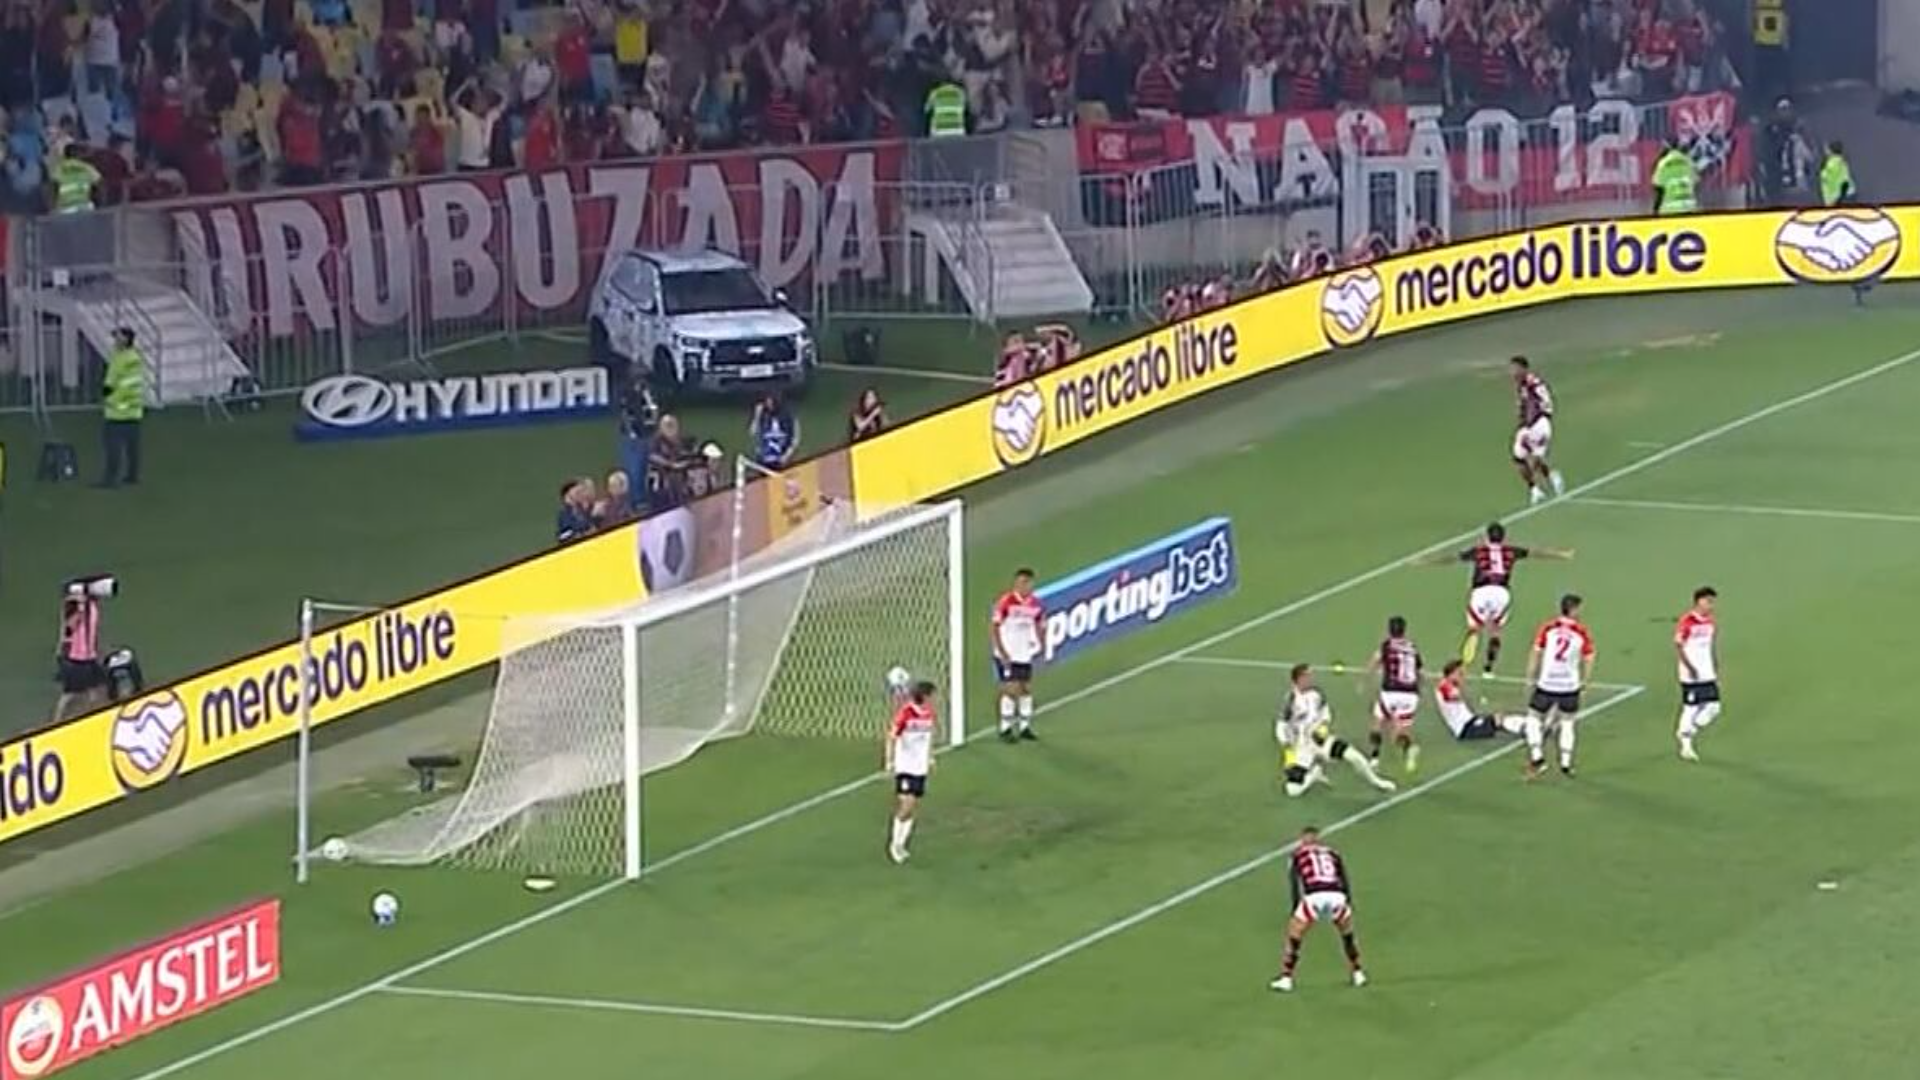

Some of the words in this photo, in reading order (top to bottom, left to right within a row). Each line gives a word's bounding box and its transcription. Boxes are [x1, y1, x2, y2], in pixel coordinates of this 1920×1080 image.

[1549, 99, 1641, 192] 12
[171, 151, 886, 337] URUBUZADA
[1396, 234, 1563, 316] mercado
[1571, 224, 1707, 279] libre
[391, 365, 609, 422] HYUNDAI
[1055, 339, 1171, 430] mercado
[1174, 322, 1238, 383] libre
[1045, 530, 1230, 661] portingbet
[1554, 637, 1570, 662] 2
[201, 631, 368, 745] mercado
[375, 610, 455, 682] libre
[68, 916, 273, 1053] AMSTEL
